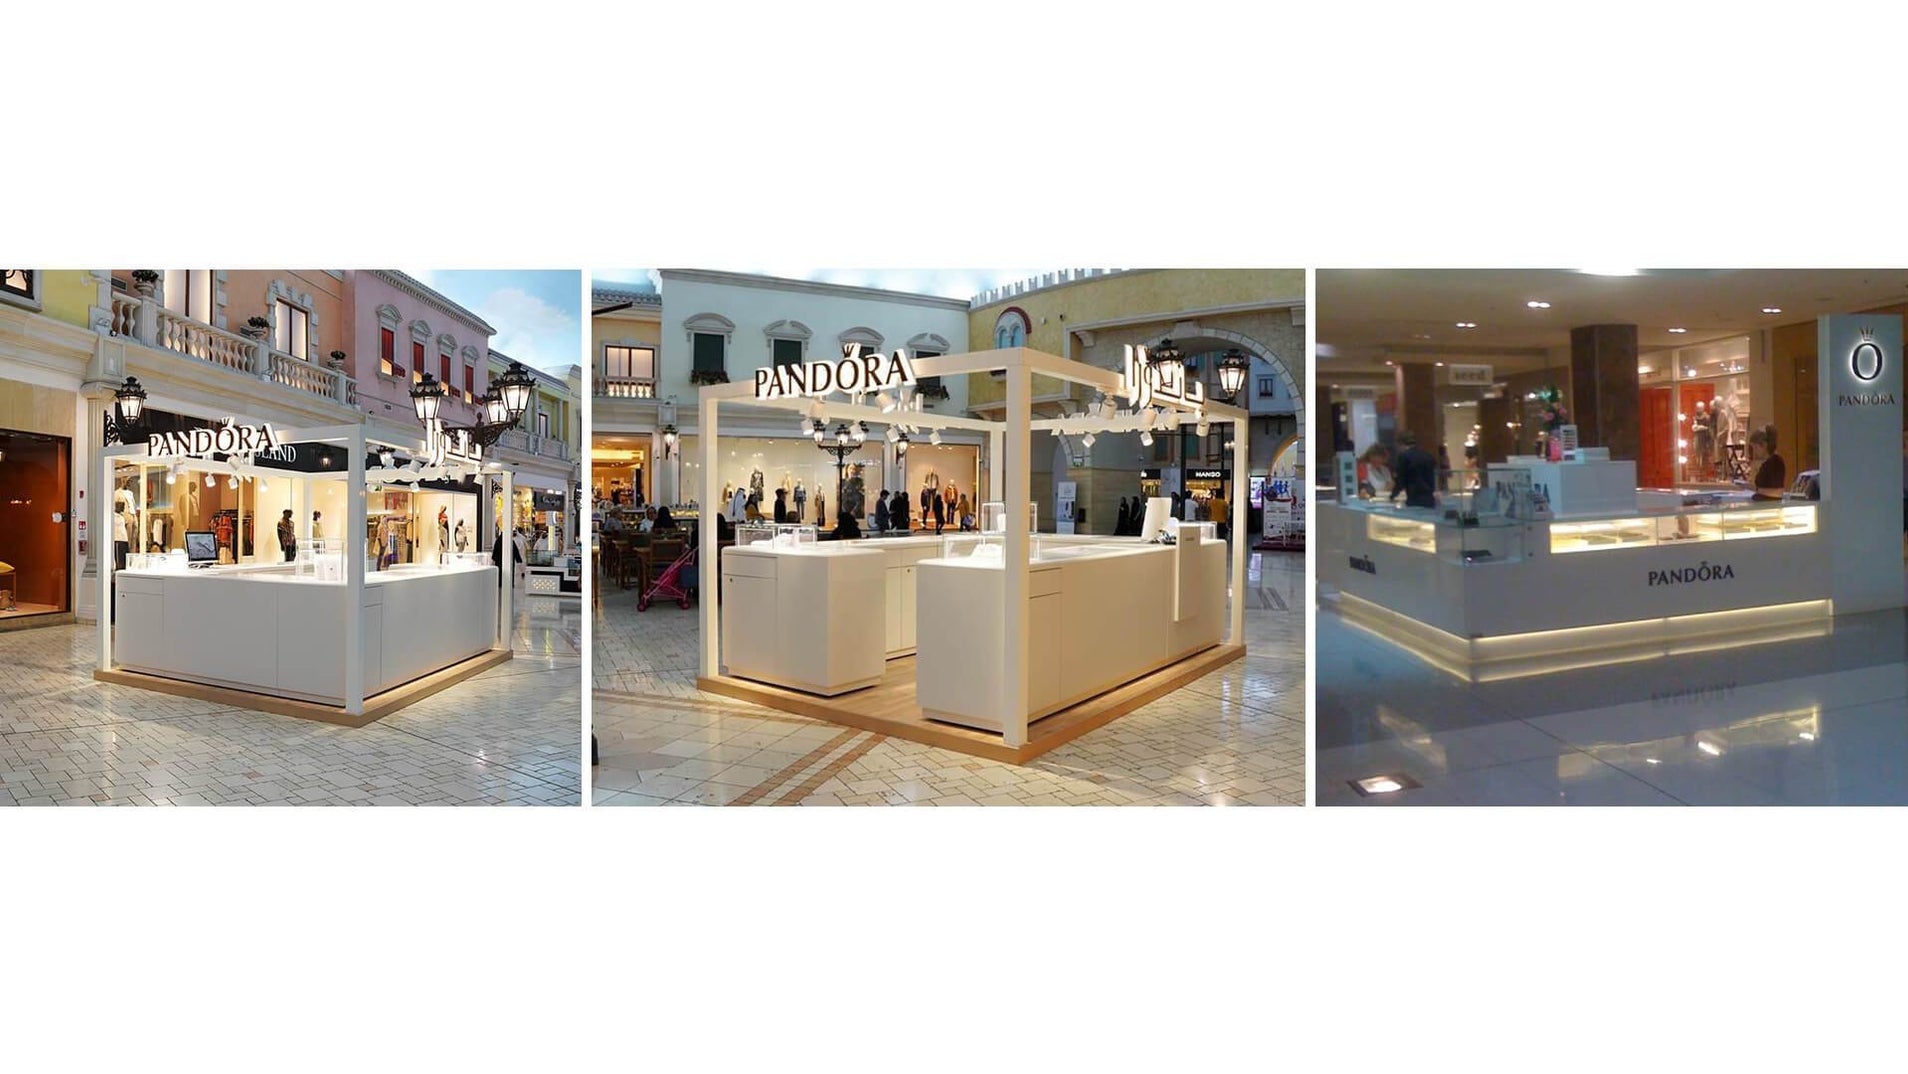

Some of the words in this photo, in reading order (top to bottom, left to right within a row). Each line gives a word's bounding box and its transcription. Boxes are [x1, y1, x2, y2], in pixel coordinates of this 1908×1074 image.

[754, 343, 915, 399] PANDORA
[1839, 391, 1895, 406] PANDORA
[148, 417, 280, 457] PANDORA
[1647, 560, 1735, 586] PANDORA
